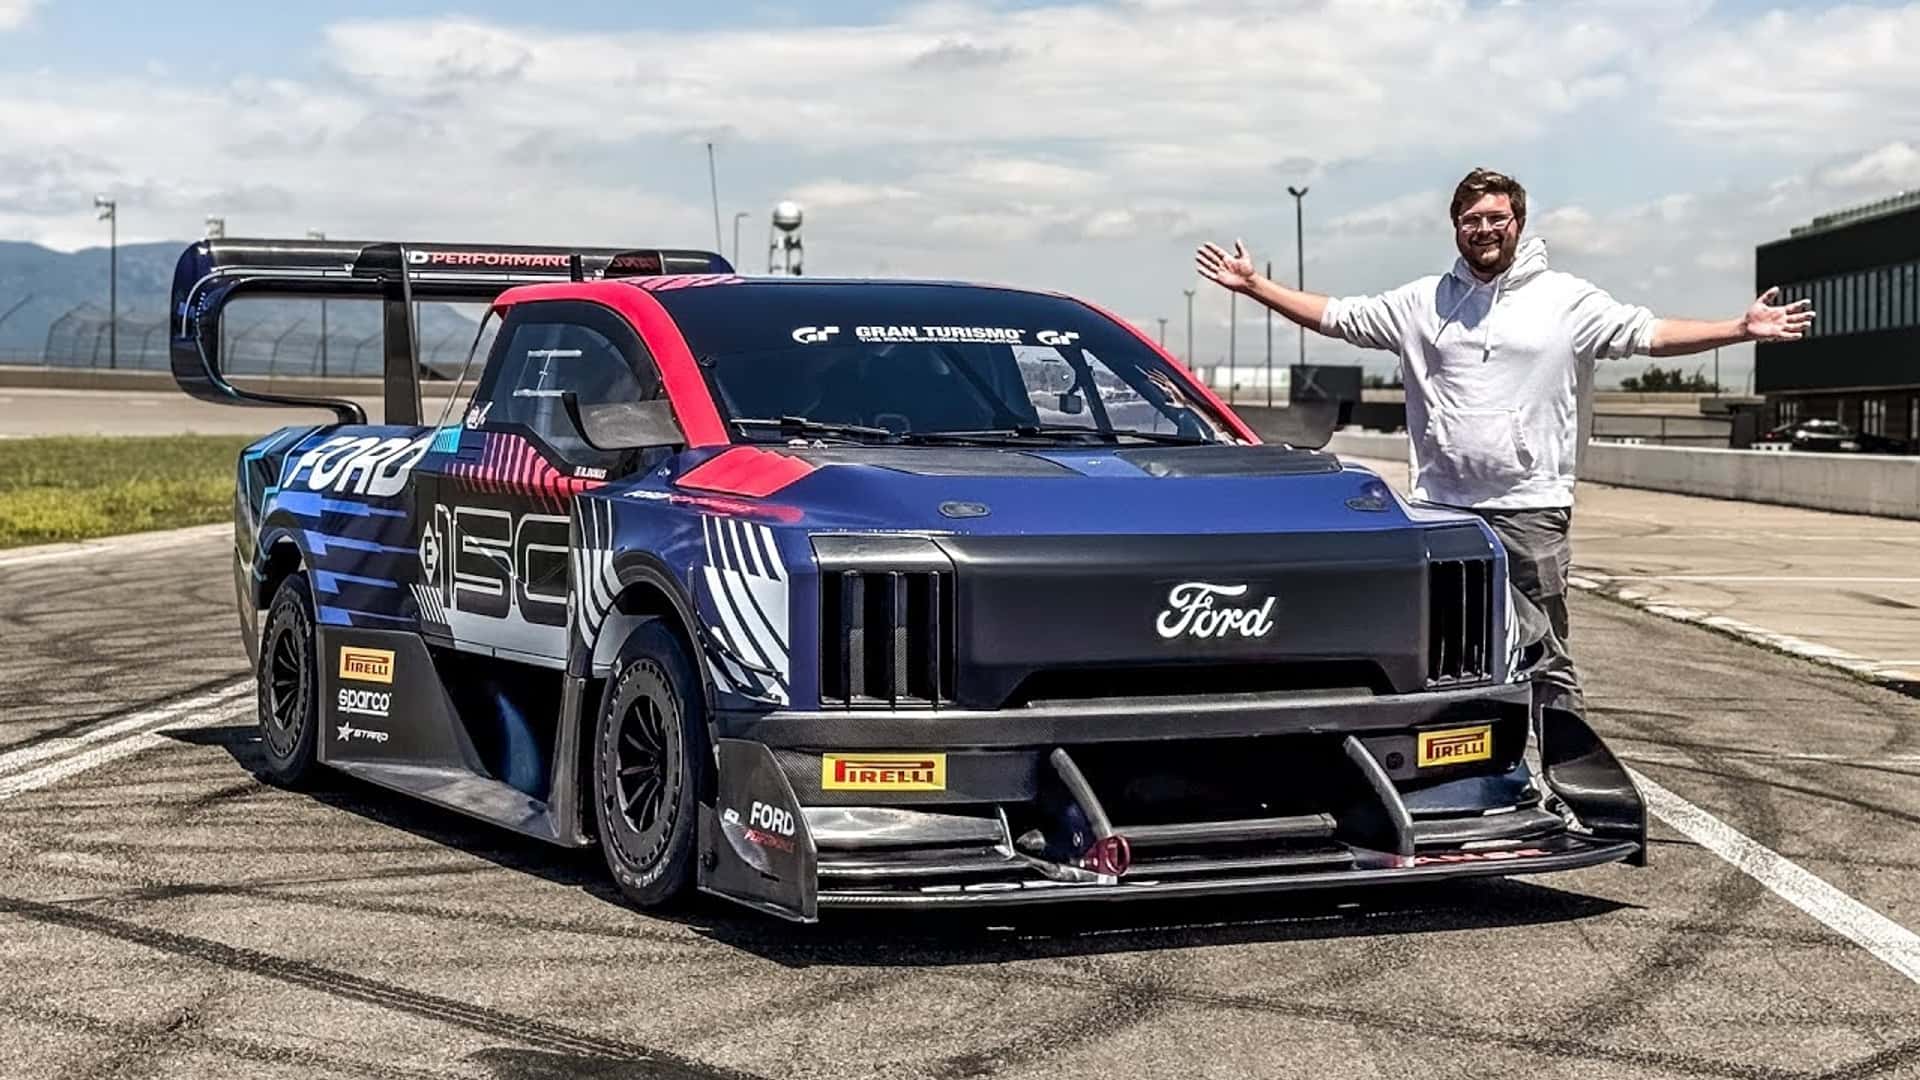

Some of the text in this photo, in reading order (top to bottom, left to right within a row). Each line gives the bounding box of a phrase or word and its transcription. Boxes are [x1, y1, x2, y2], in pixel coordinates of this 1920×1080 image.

[431, 252, 572, 267] PERFORMANC
[855, 326, 1021, 340] GRAN TURISMO
[282, 436, 431, 497] FORD
[1156, 582, 1276, 638] Ford
[344, 653, 390, 676] PIRELLI
[338, 688, 390, 713] sparco
[1426, 731, 1485, 760] PIRELLI
[835, 759, 935, 783] PIRELLI
[750, 801, 795, 837] FORD
